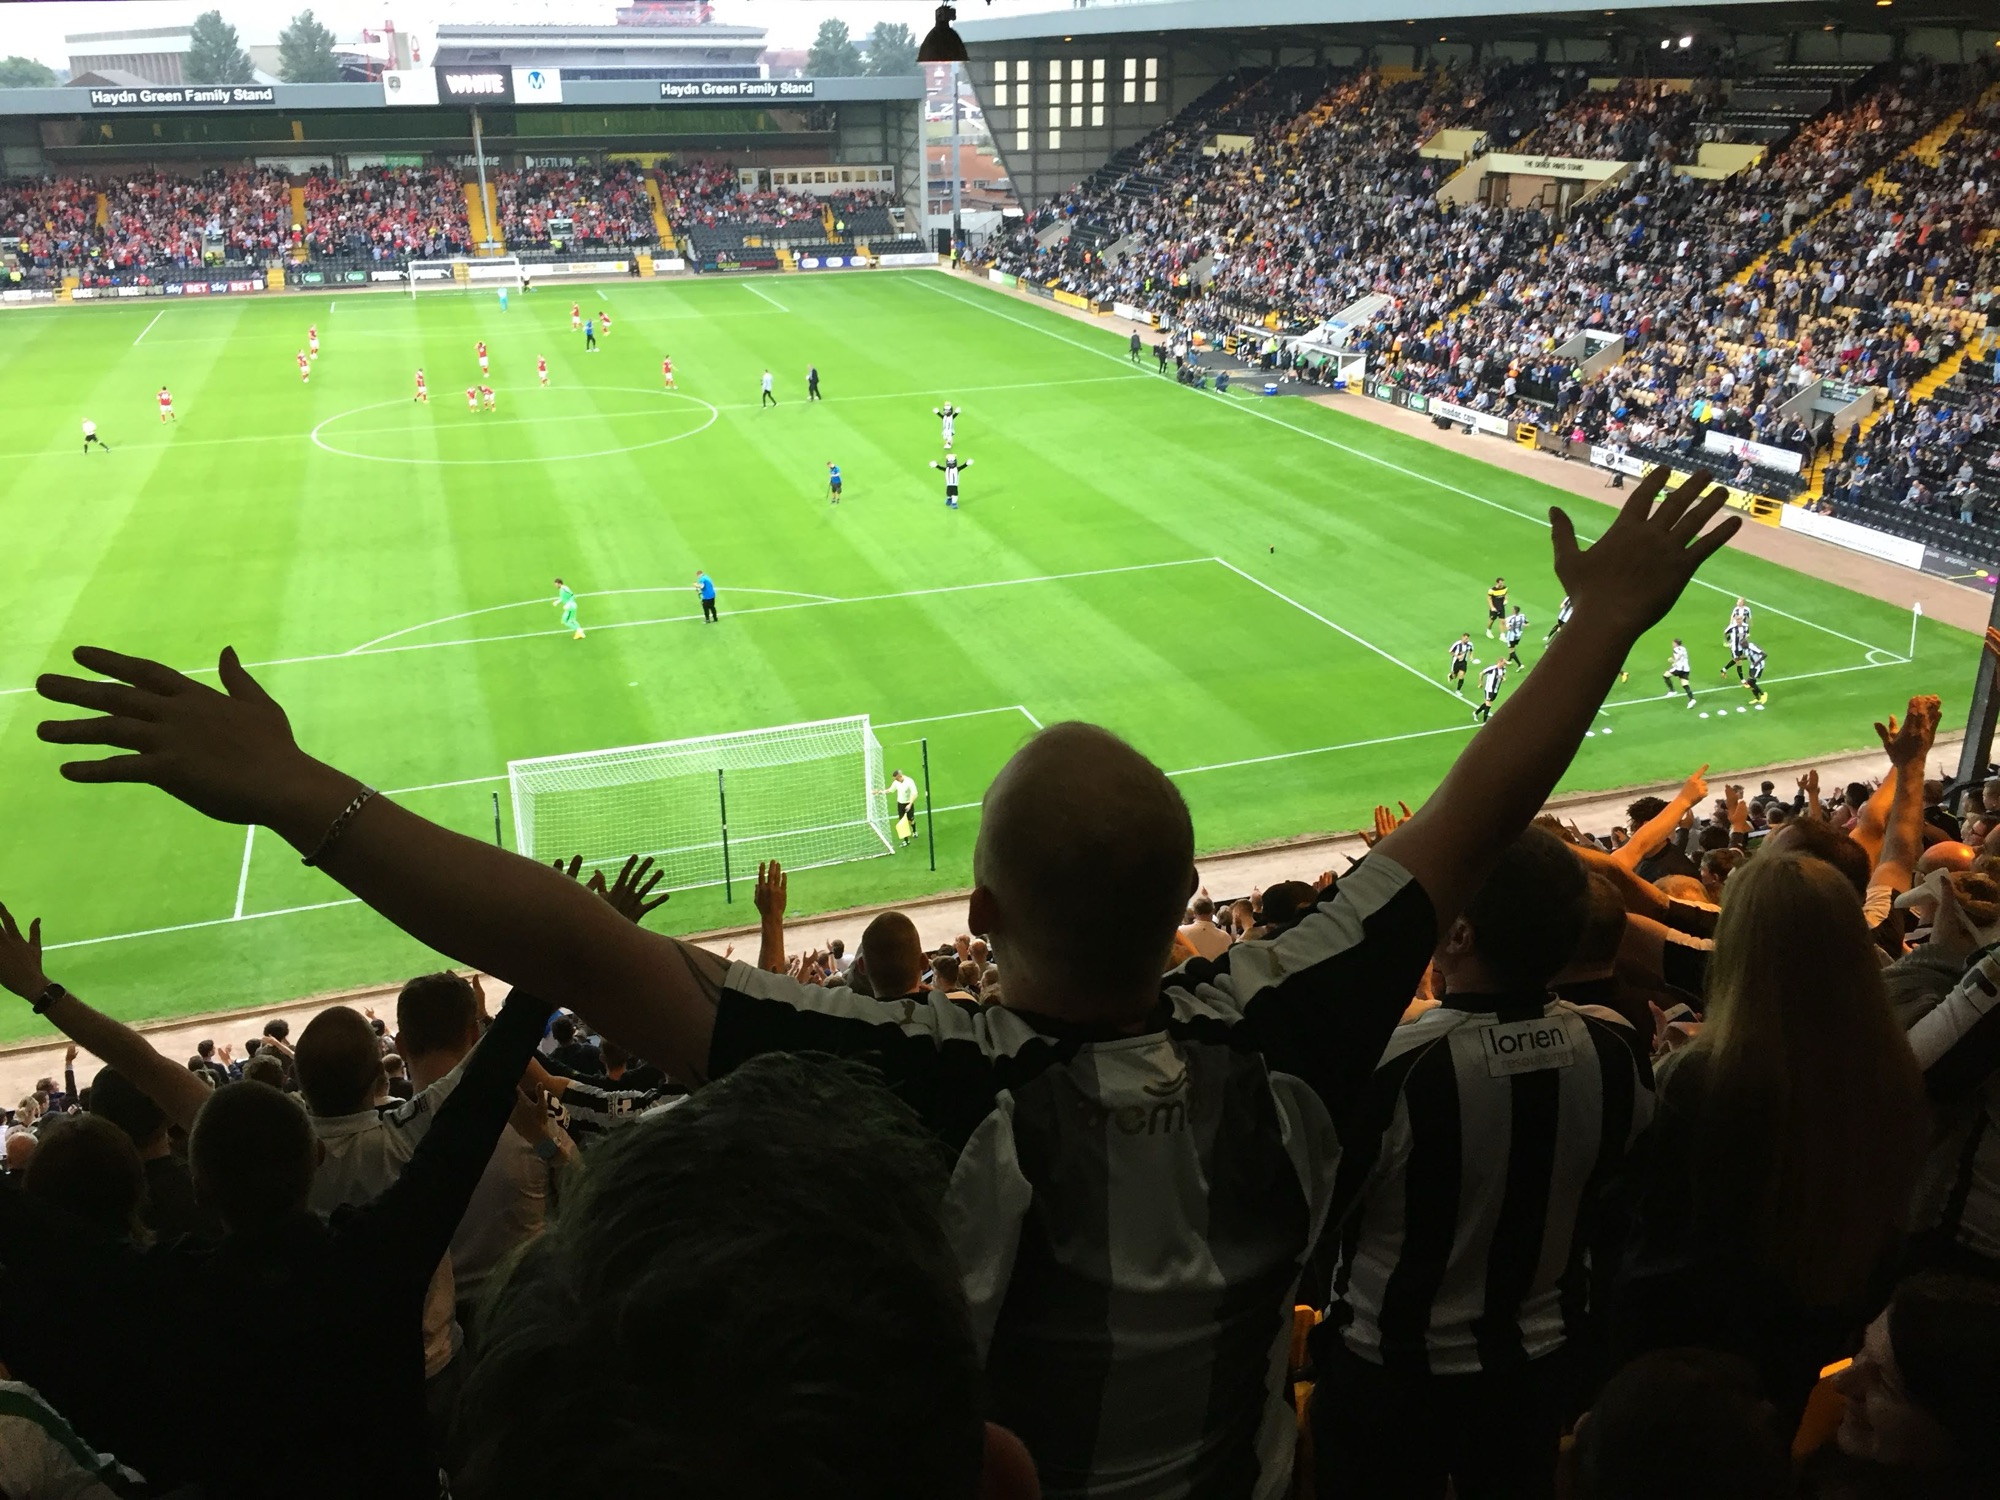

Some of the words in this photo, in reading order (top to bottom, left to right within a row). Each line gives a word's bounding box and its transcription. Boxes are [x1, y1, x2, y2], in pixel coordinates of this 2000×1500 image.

[445, 74, 505, 94] WHITE
[661, 83, 700, 98] Haydn
[702, 82, 737, 95] Green
[739, 81, 778, 97] Family
[780, 81, 813, 94] Stand
[91, 90, 136, 105] Haydn
[140, 89, 182, 103] Green
[184, 87, 231, 104] Family
[233, 87, 273, 101] Stand
[166, 282, 183, 295] sky
[186, 283, 208, 294] BET
[210, 281, 228, 293] sky
[230, 281, 251, 292] BET
[1488, 1026, 1565, 1056] lorien
